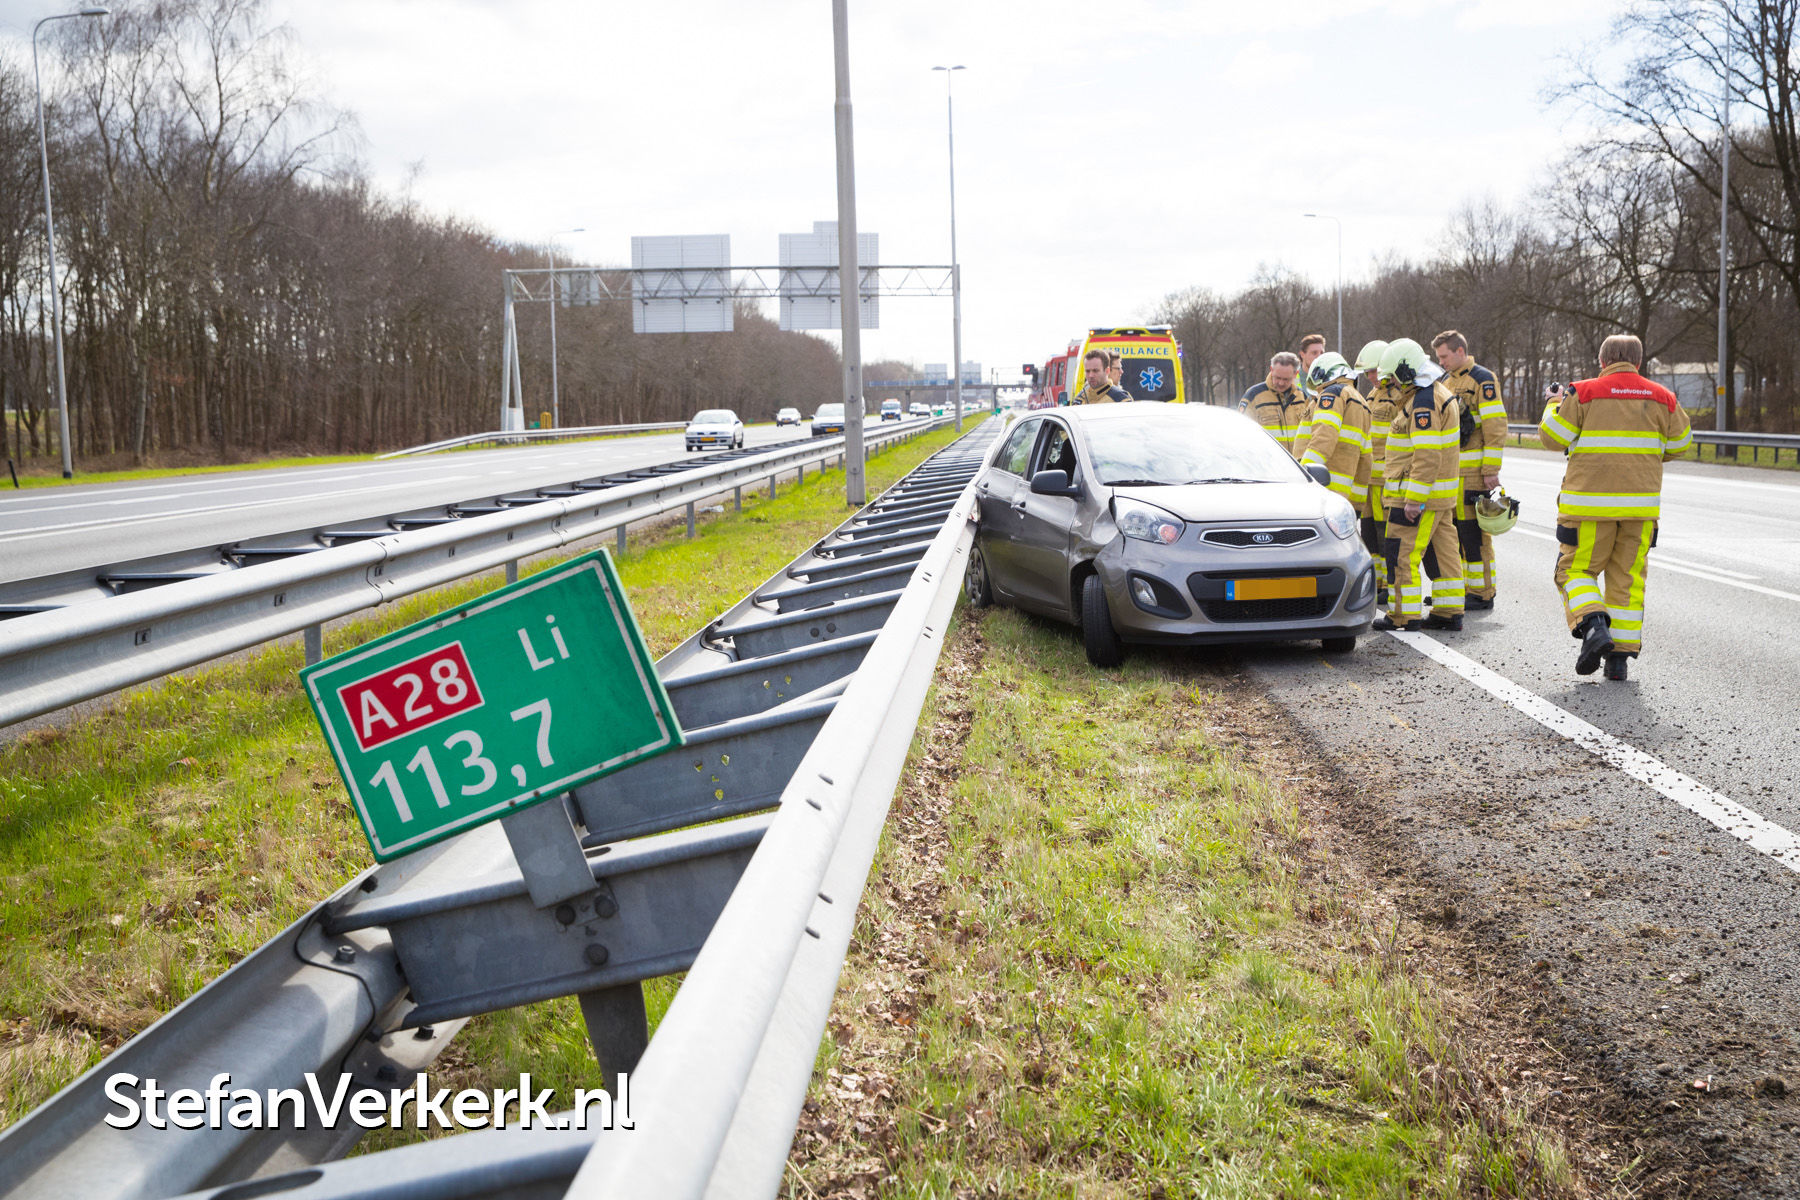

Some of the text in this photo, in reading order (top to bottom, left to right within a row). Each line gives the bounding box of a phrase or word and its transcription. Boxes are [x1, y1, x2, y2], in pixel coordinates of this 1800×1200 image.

[1104, 347, 1168, 355] BULANCE
[1255, 534, 1271, 542] KIA
[360, 614, 570, 739] A28 Li
[369, 698, 555, 823] 113,7
